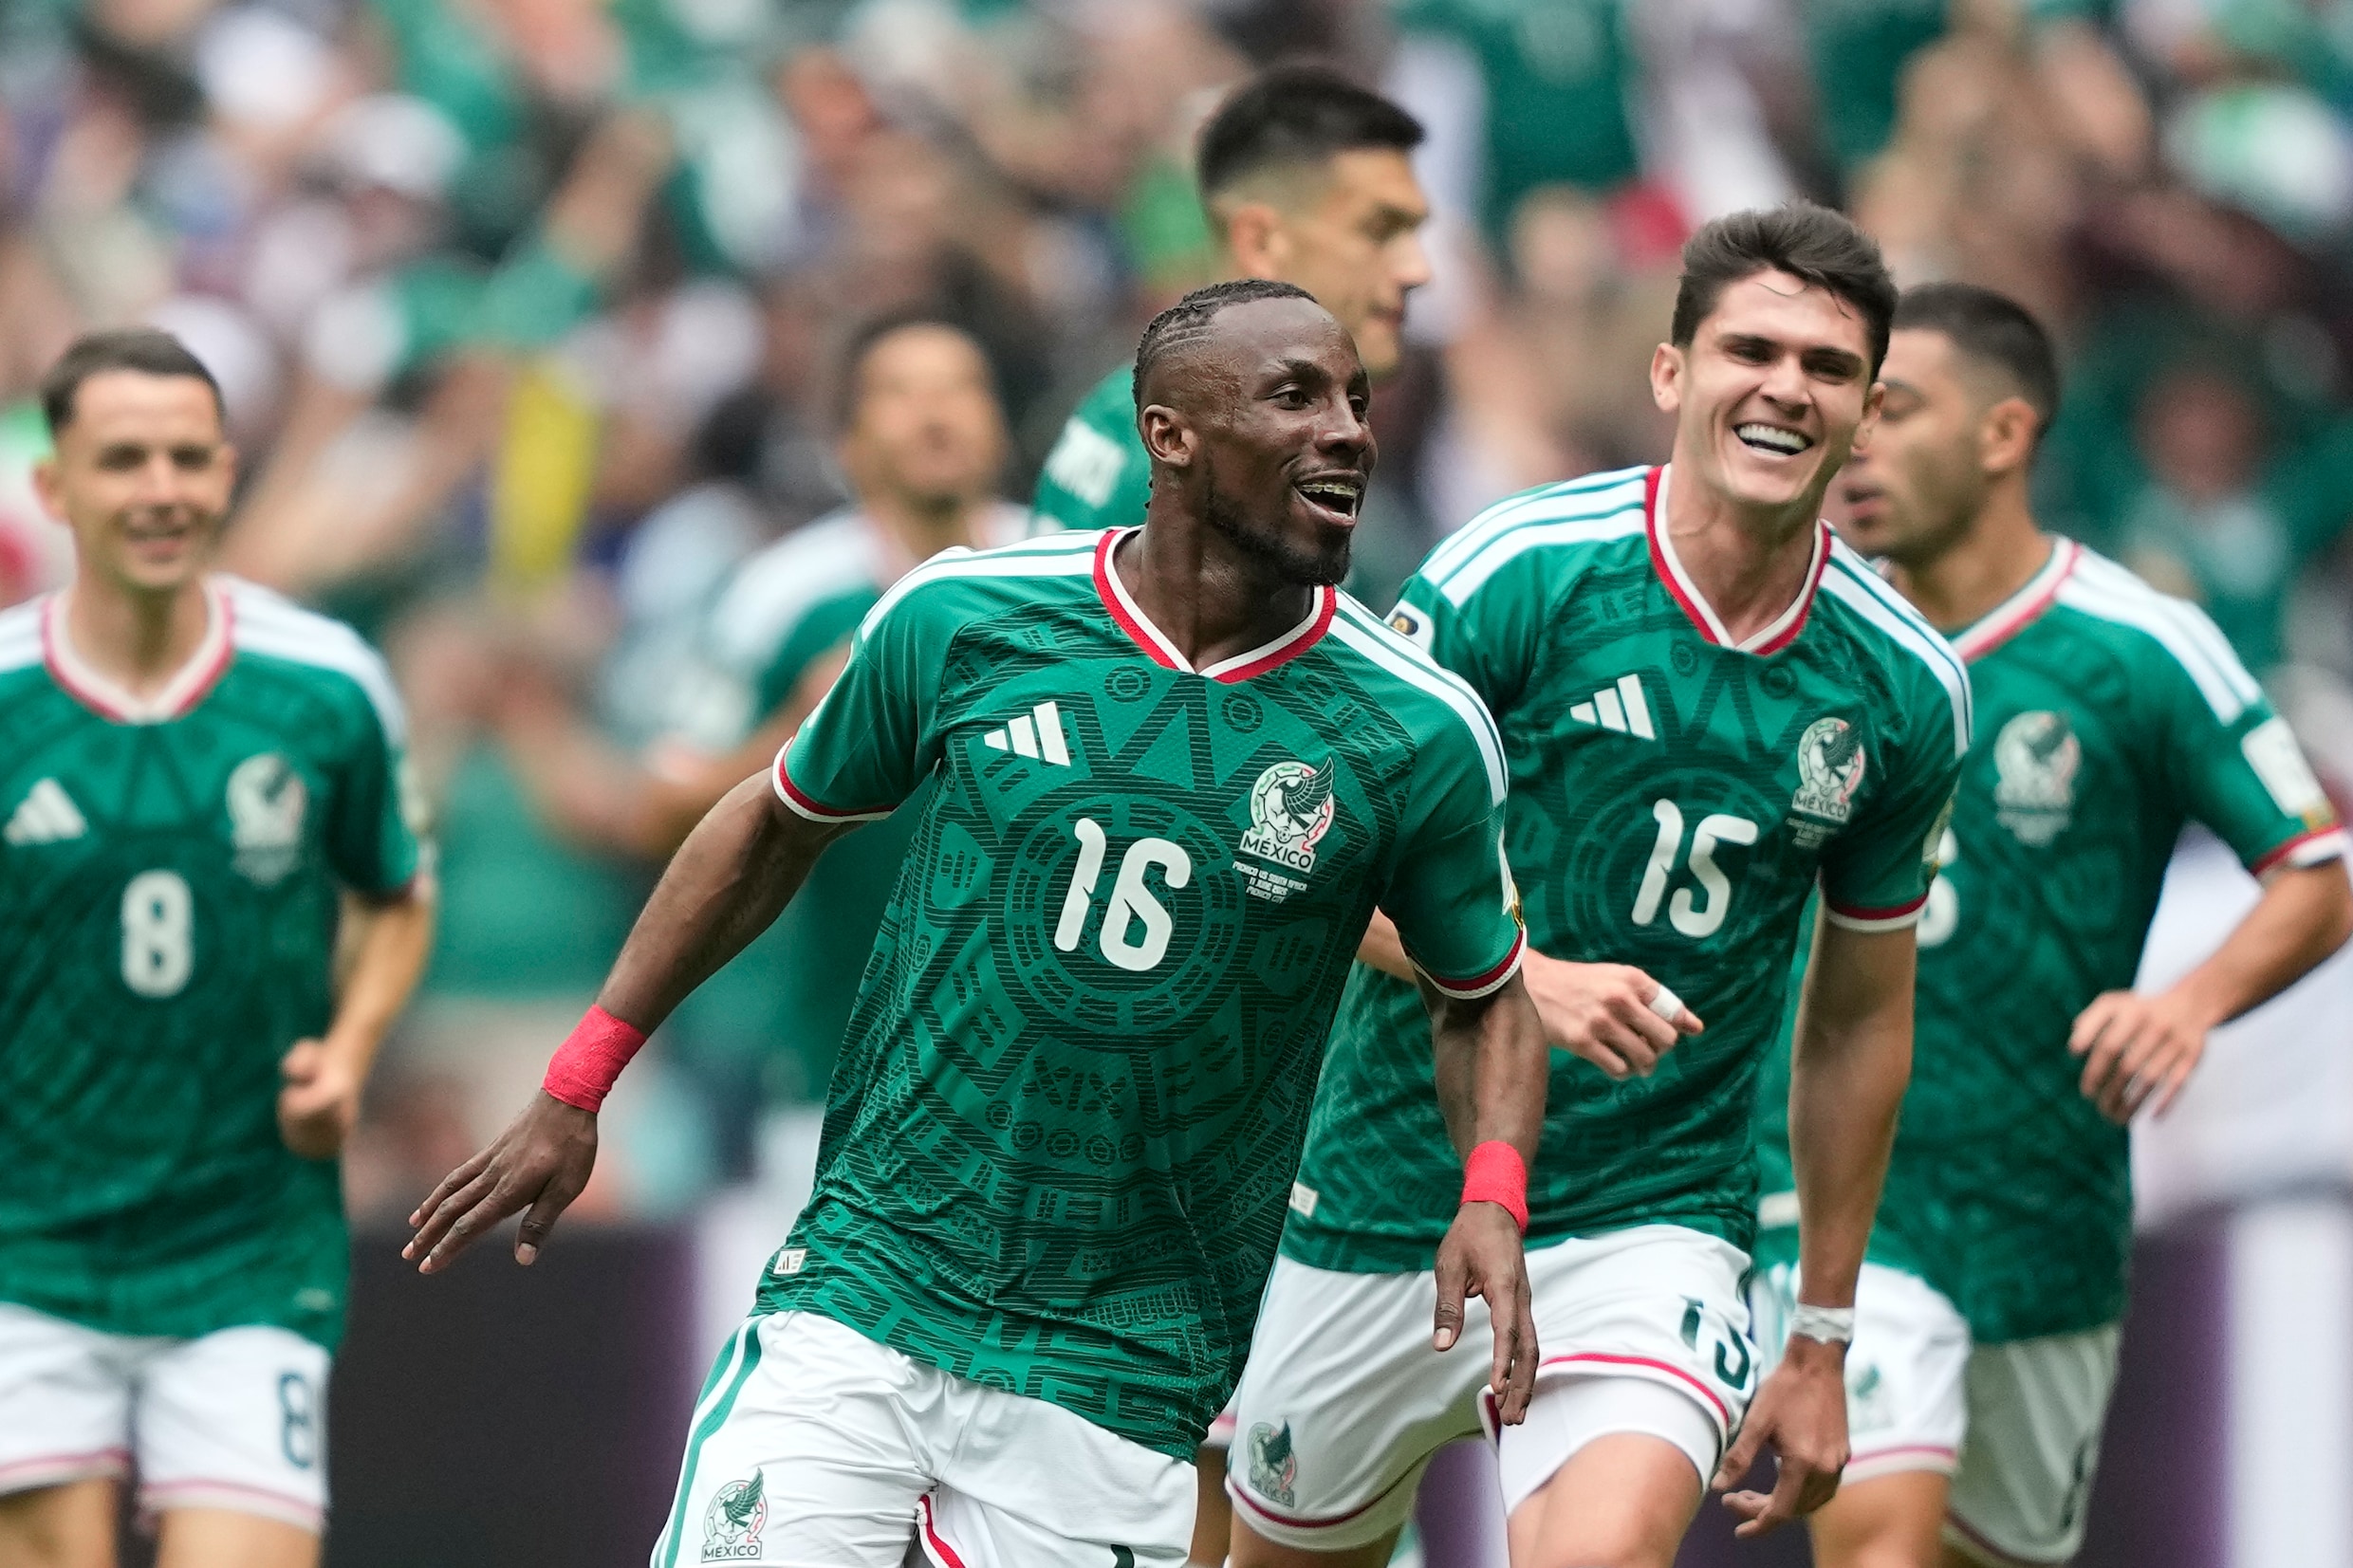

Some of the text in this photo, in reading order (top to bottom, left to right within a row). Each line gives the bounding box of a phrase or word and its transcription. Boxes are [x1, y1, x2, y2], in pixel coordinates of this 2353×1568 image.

[1054, 818, 1192, 971] 16
[1243, 836, 1311, 869] MÉXICO
[1631, 799, 1759, 939] 15
[120, 869, 195, 999] 8
[277, 1372, 315, 1469] 8
[703, 1543, 759, 1559] MÉXICO
